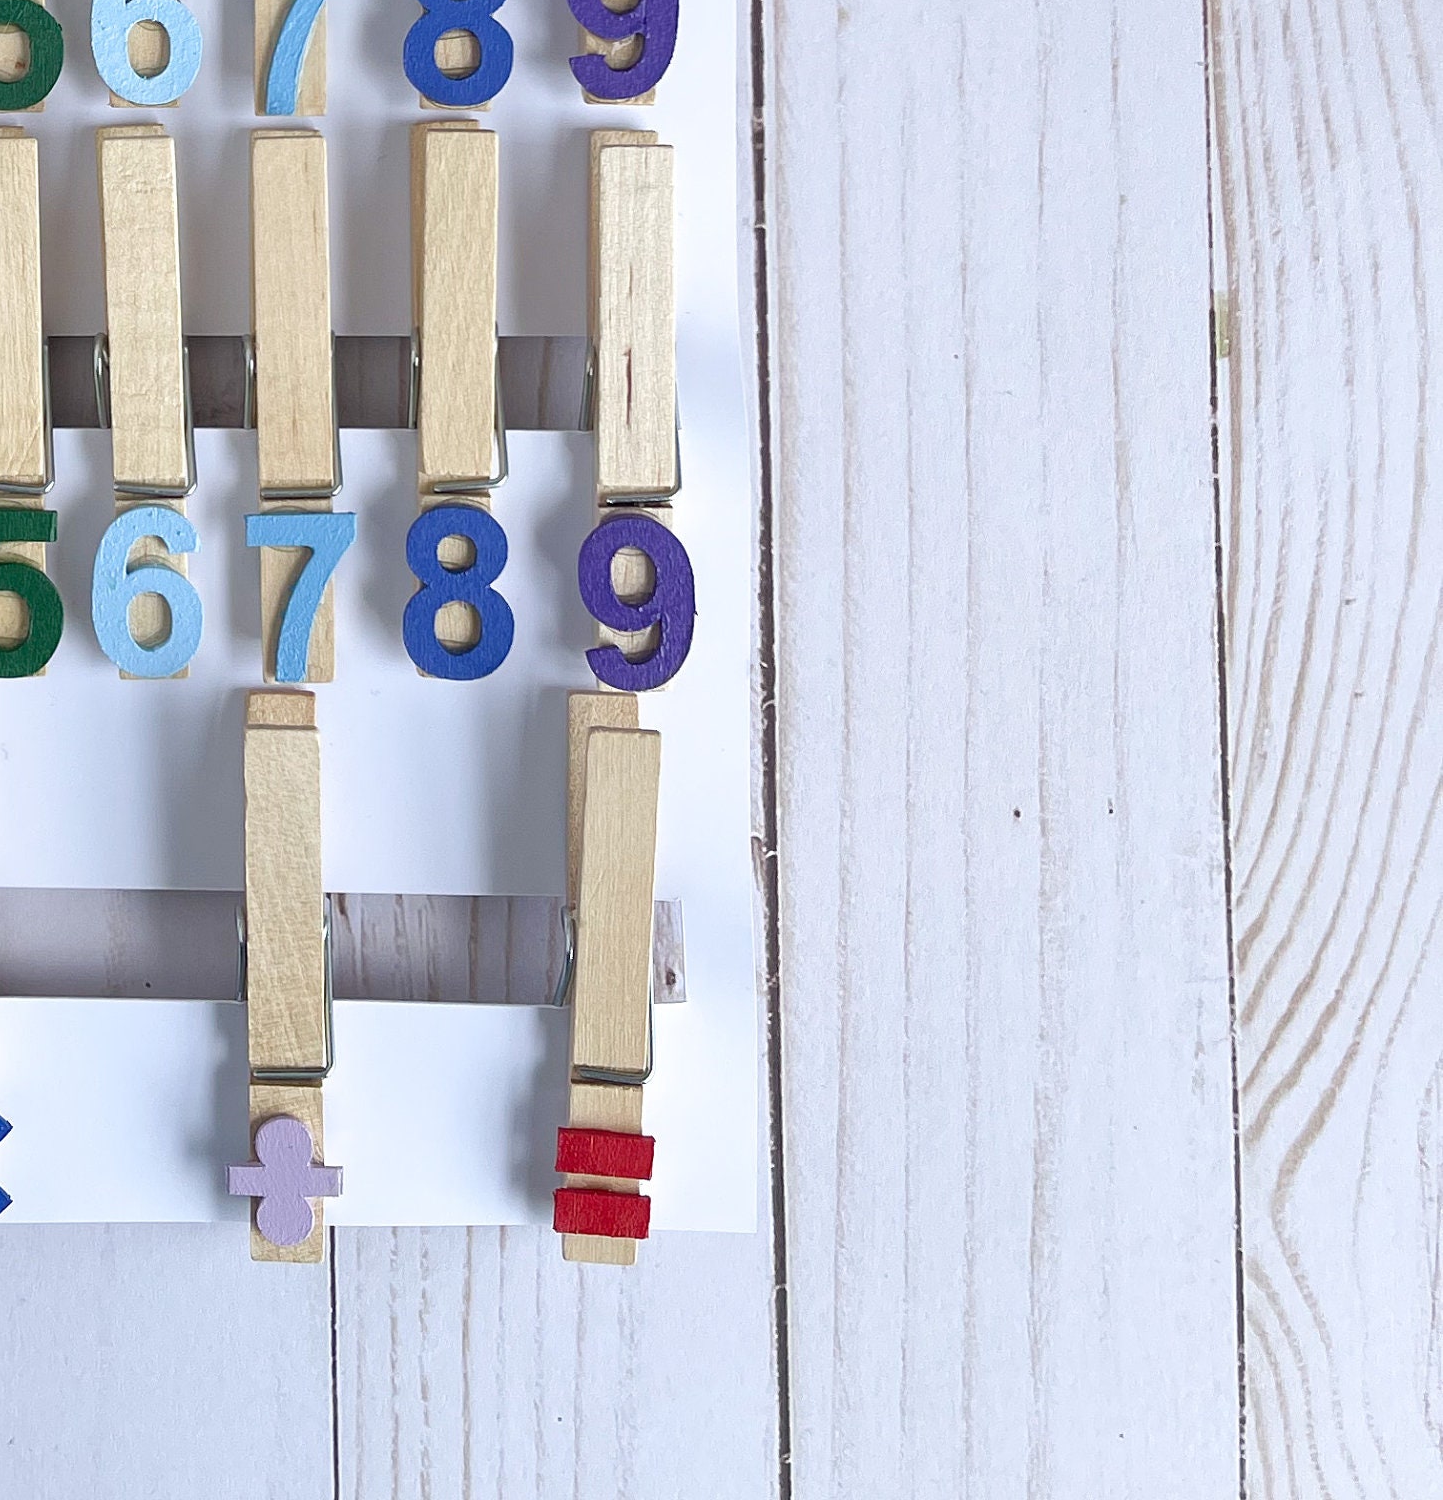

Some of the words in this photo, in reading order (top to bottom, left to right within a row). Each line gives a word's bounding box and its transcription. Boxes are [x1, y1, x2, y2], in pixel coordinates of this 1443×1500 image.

[91, 507, 202, 676] 6
[244, 512, 356, 682] 7
[403, 506, 514, 680] 8
[578, 516, 695, 691] 9
